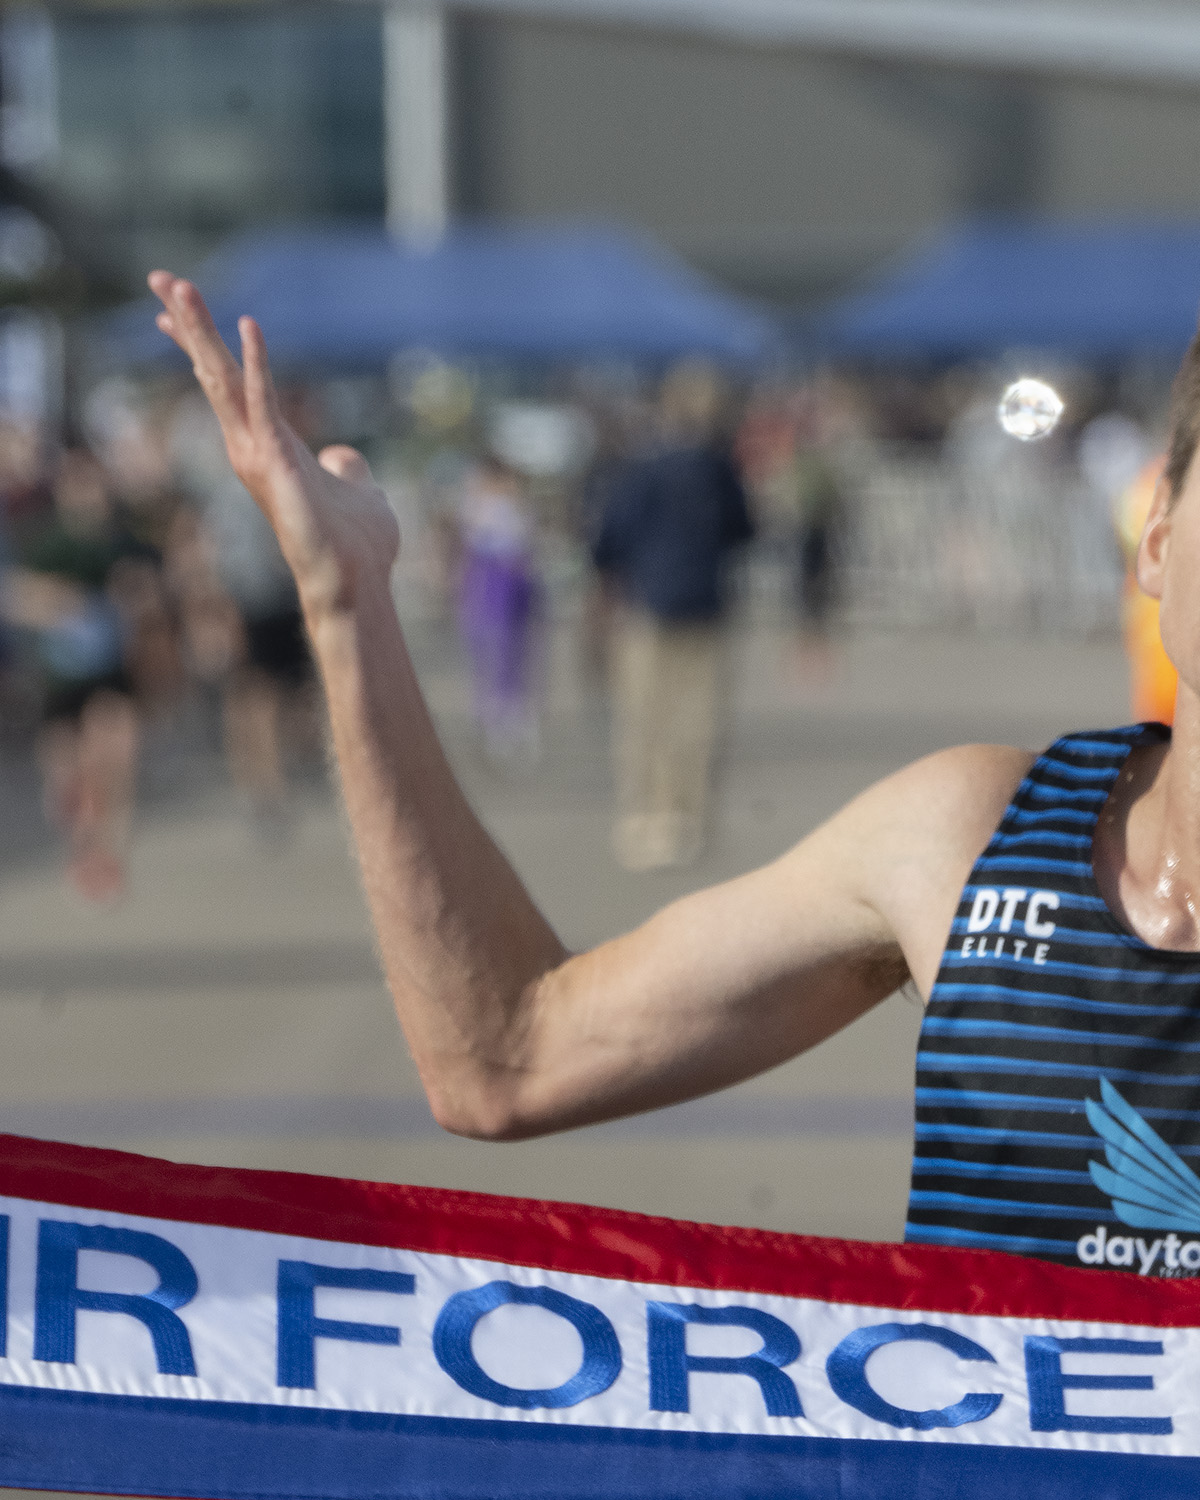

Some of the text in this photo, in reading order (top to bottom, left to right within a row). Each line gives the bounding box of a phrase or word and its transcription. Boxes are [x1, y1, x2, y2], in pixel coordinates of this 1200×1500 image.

[967, 888, 1060, 939] DTC
[961, 936, 1050, 965] ELITE
[0, 1213, 198, 1377] R
[276, 1259, 1173, 1434] FORCE
